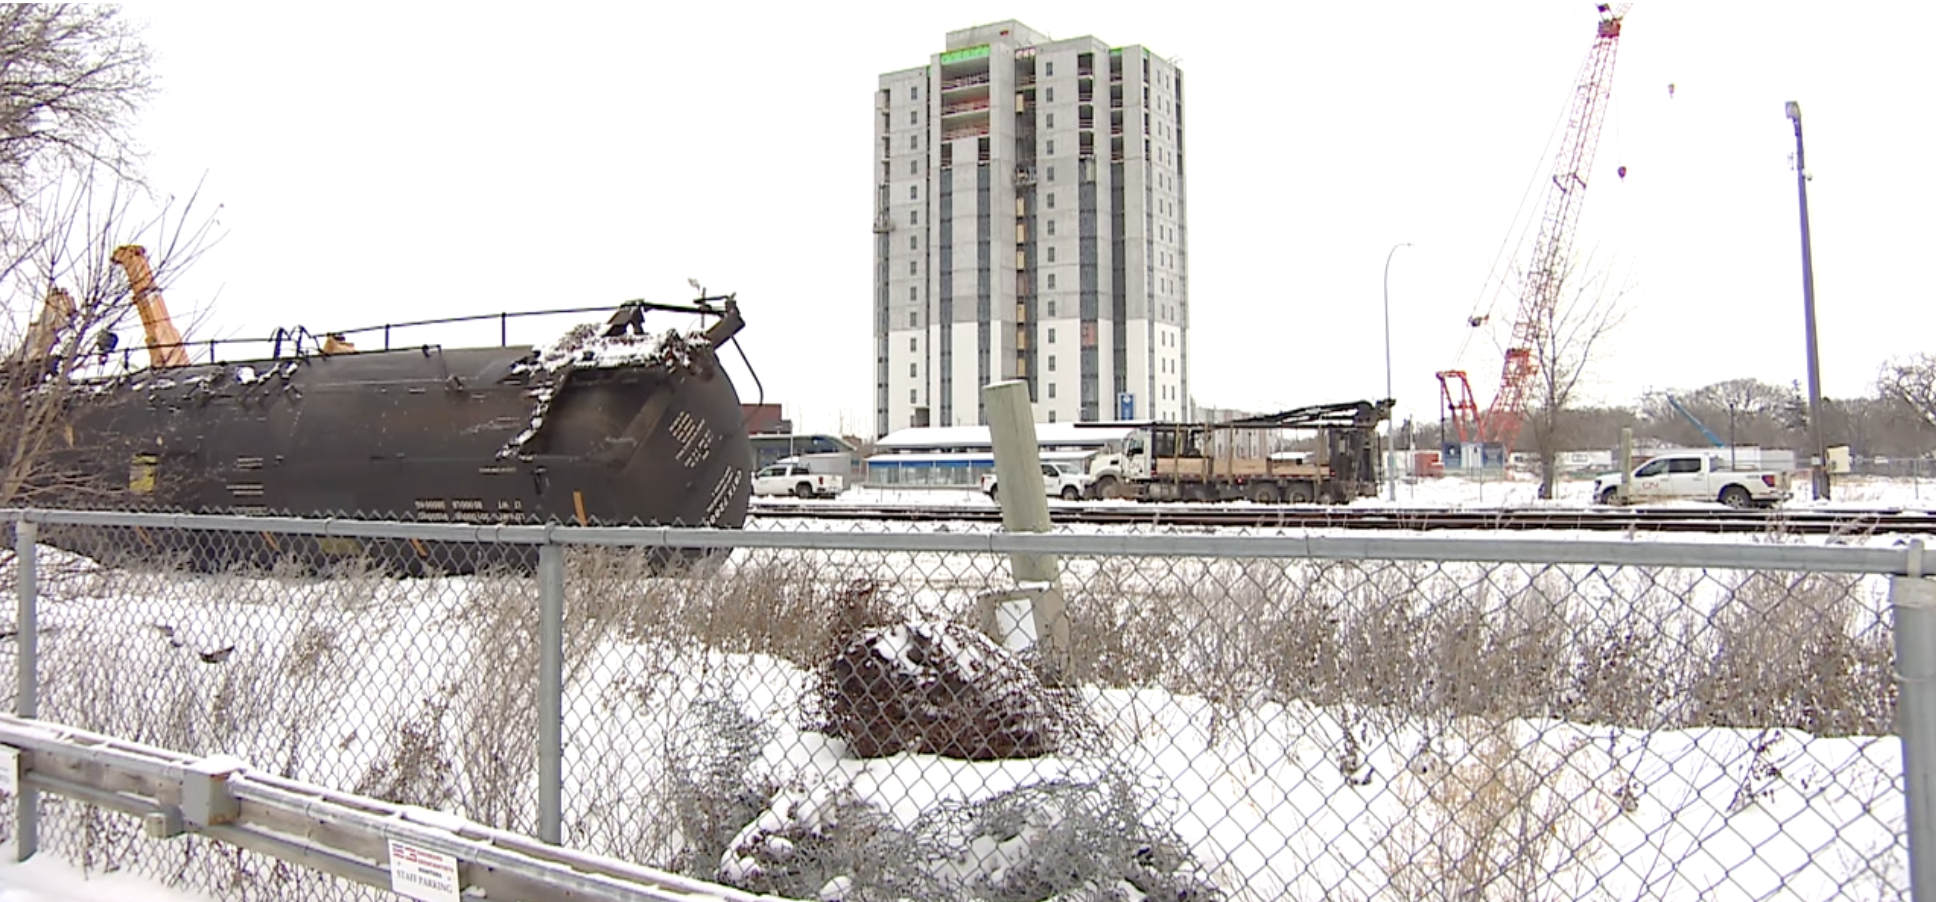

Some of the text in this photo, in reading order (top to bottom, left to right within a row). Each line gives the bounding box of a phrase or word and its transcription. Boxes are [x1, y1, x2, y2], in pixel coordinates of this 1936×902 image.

[1642, 481, 1658, 489] CN
[396, 870, 453, 894] STAFF PARKING
